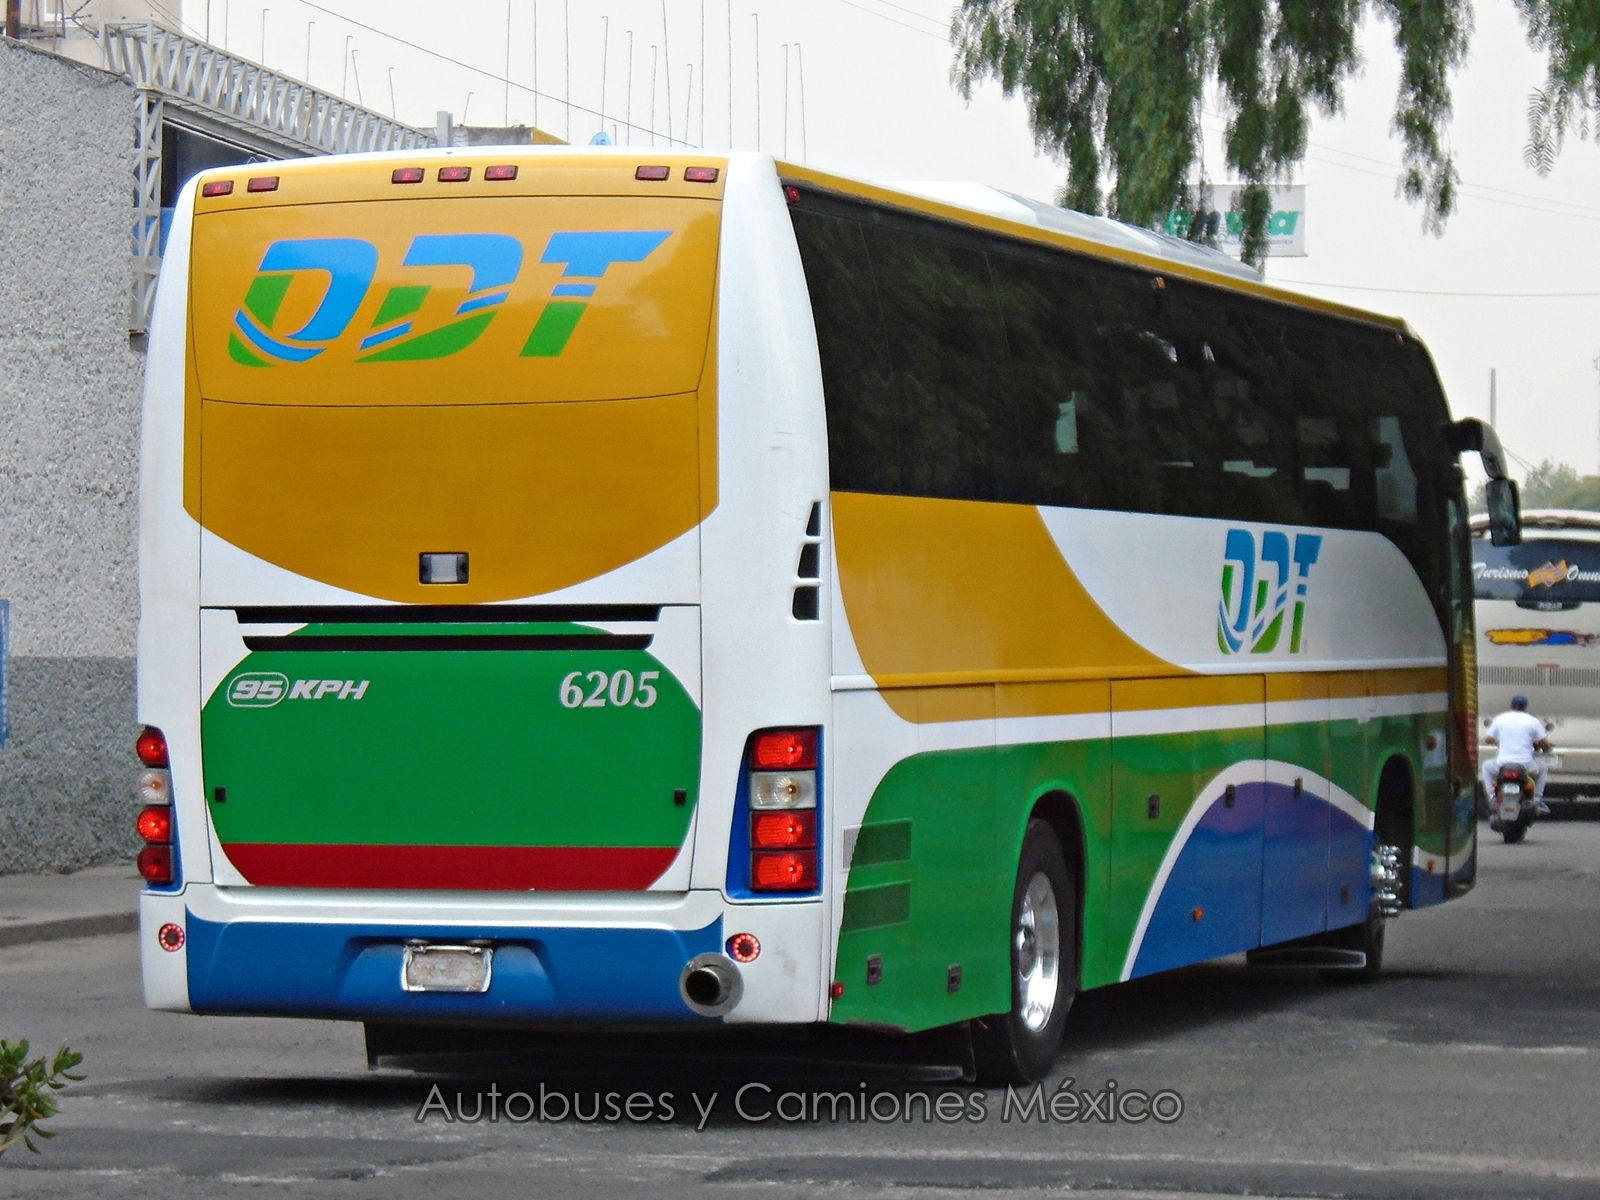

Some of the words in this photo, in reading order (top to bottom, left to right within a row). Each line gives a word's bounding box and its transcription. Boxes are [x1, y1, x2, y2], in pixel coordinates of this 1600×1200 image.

[1473, 562, 1528, 580] Turismo
[232, 680, 284, 700] 95
[289, 679, 370, 700] KPH
[559, 670, 659, 708] 6205
